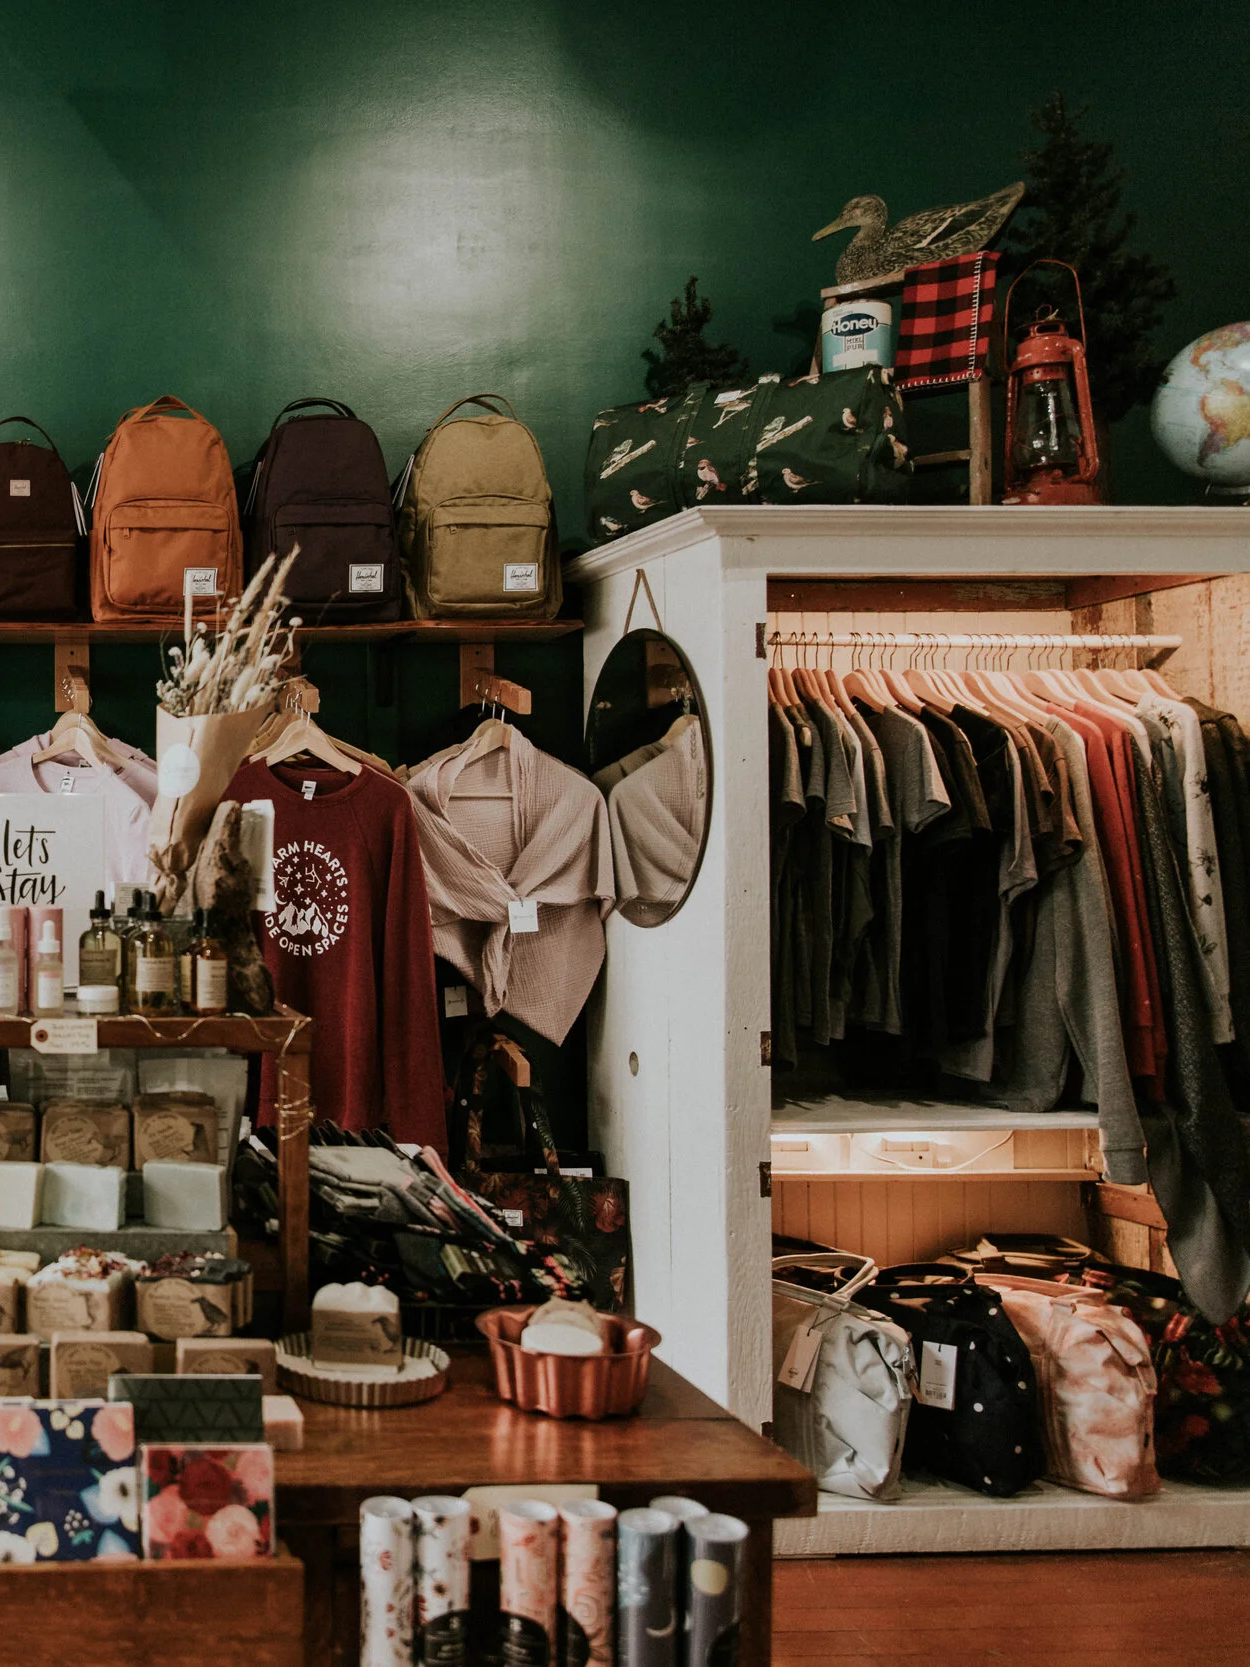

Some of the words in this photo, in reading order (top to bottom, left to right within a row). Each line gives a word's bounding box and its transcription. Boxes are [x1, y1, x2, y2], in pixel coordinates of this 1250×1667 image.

[831, 318, 877, 335] Honey
[846, 344, 863, 352] PUR
[3, 819, 56, 868] let's
[271, 841, 300, 872] ARM
[303, 840, 348, 887] HEARTS
[264, 911, 281, 938] IDE
[279, 936, 312, 956] OPEN
[314, 904, 349, 955] SPACES
